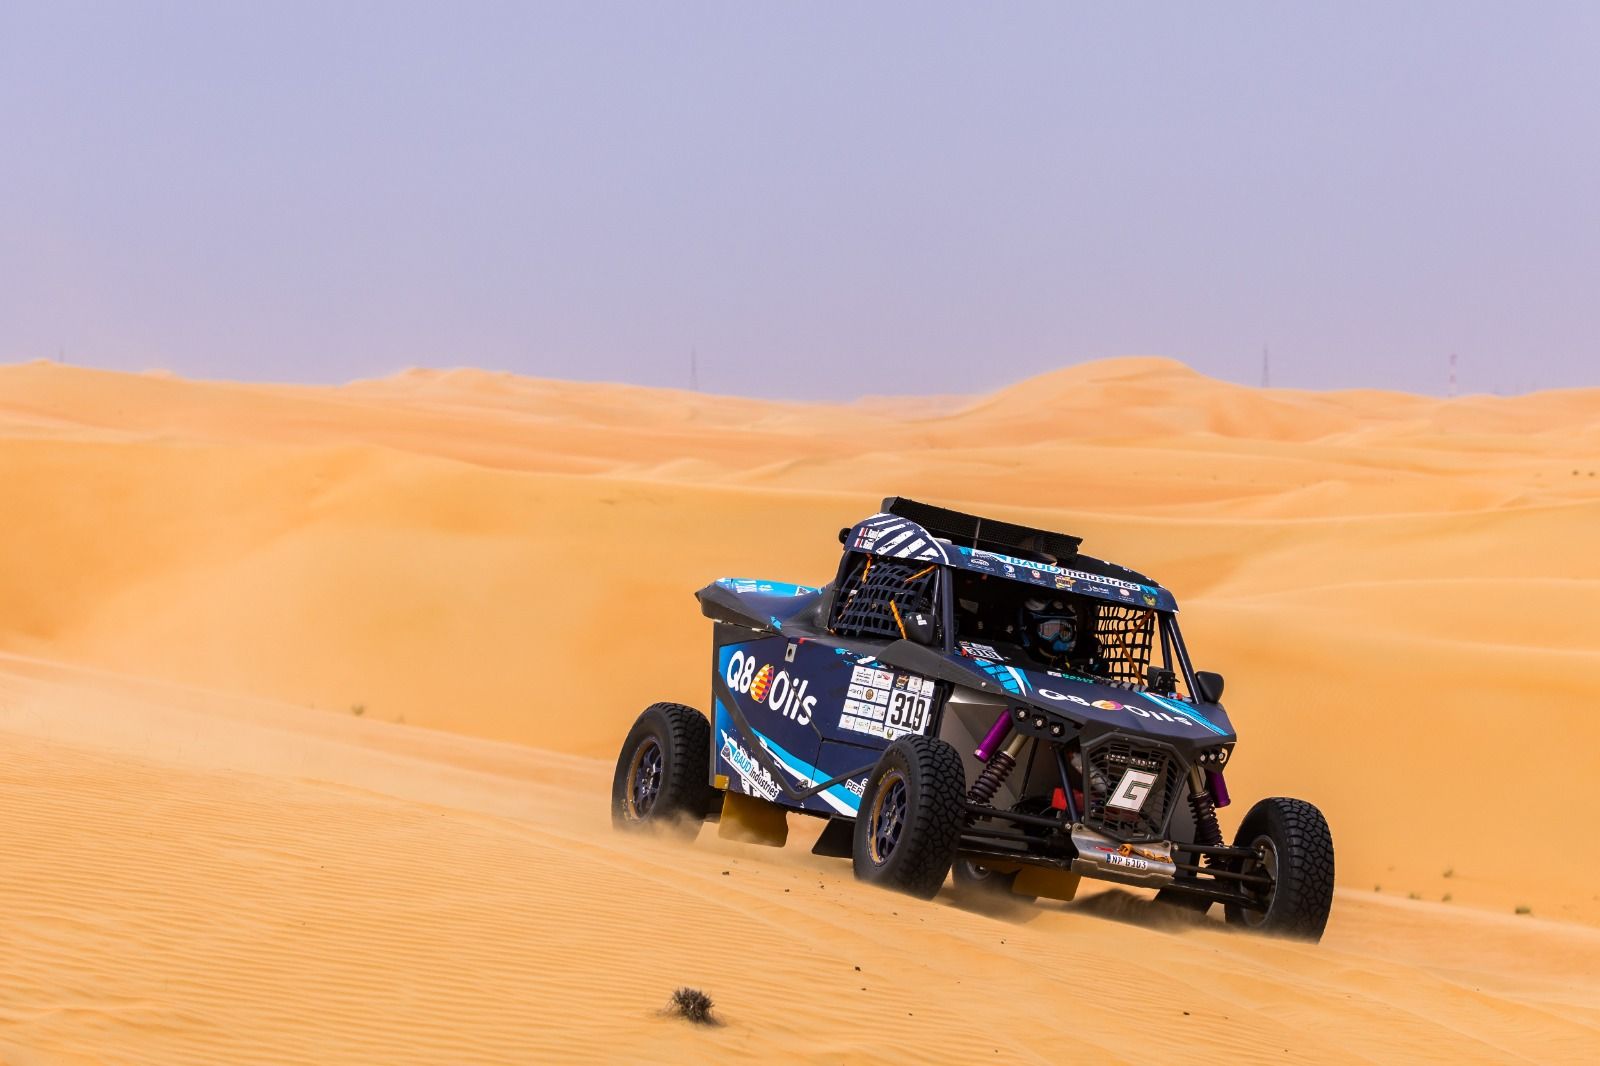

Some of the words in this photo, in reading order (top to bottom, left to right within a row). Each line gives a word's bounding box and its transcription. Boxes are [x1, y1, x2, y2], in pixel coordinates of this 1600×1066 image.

[1010, 556, 1061, 574] BAUD
[727, 650, 756, 694] Q8
[768, 670, 818, 726] Oils
[1038, 688, 1091, 706] Q8
[1123, 704, 1193, 726] Oils
[890, 692, 926, 732] 319
[733, 750, 752, 773] BAUD
[1106, 767, 1159, 812] G
